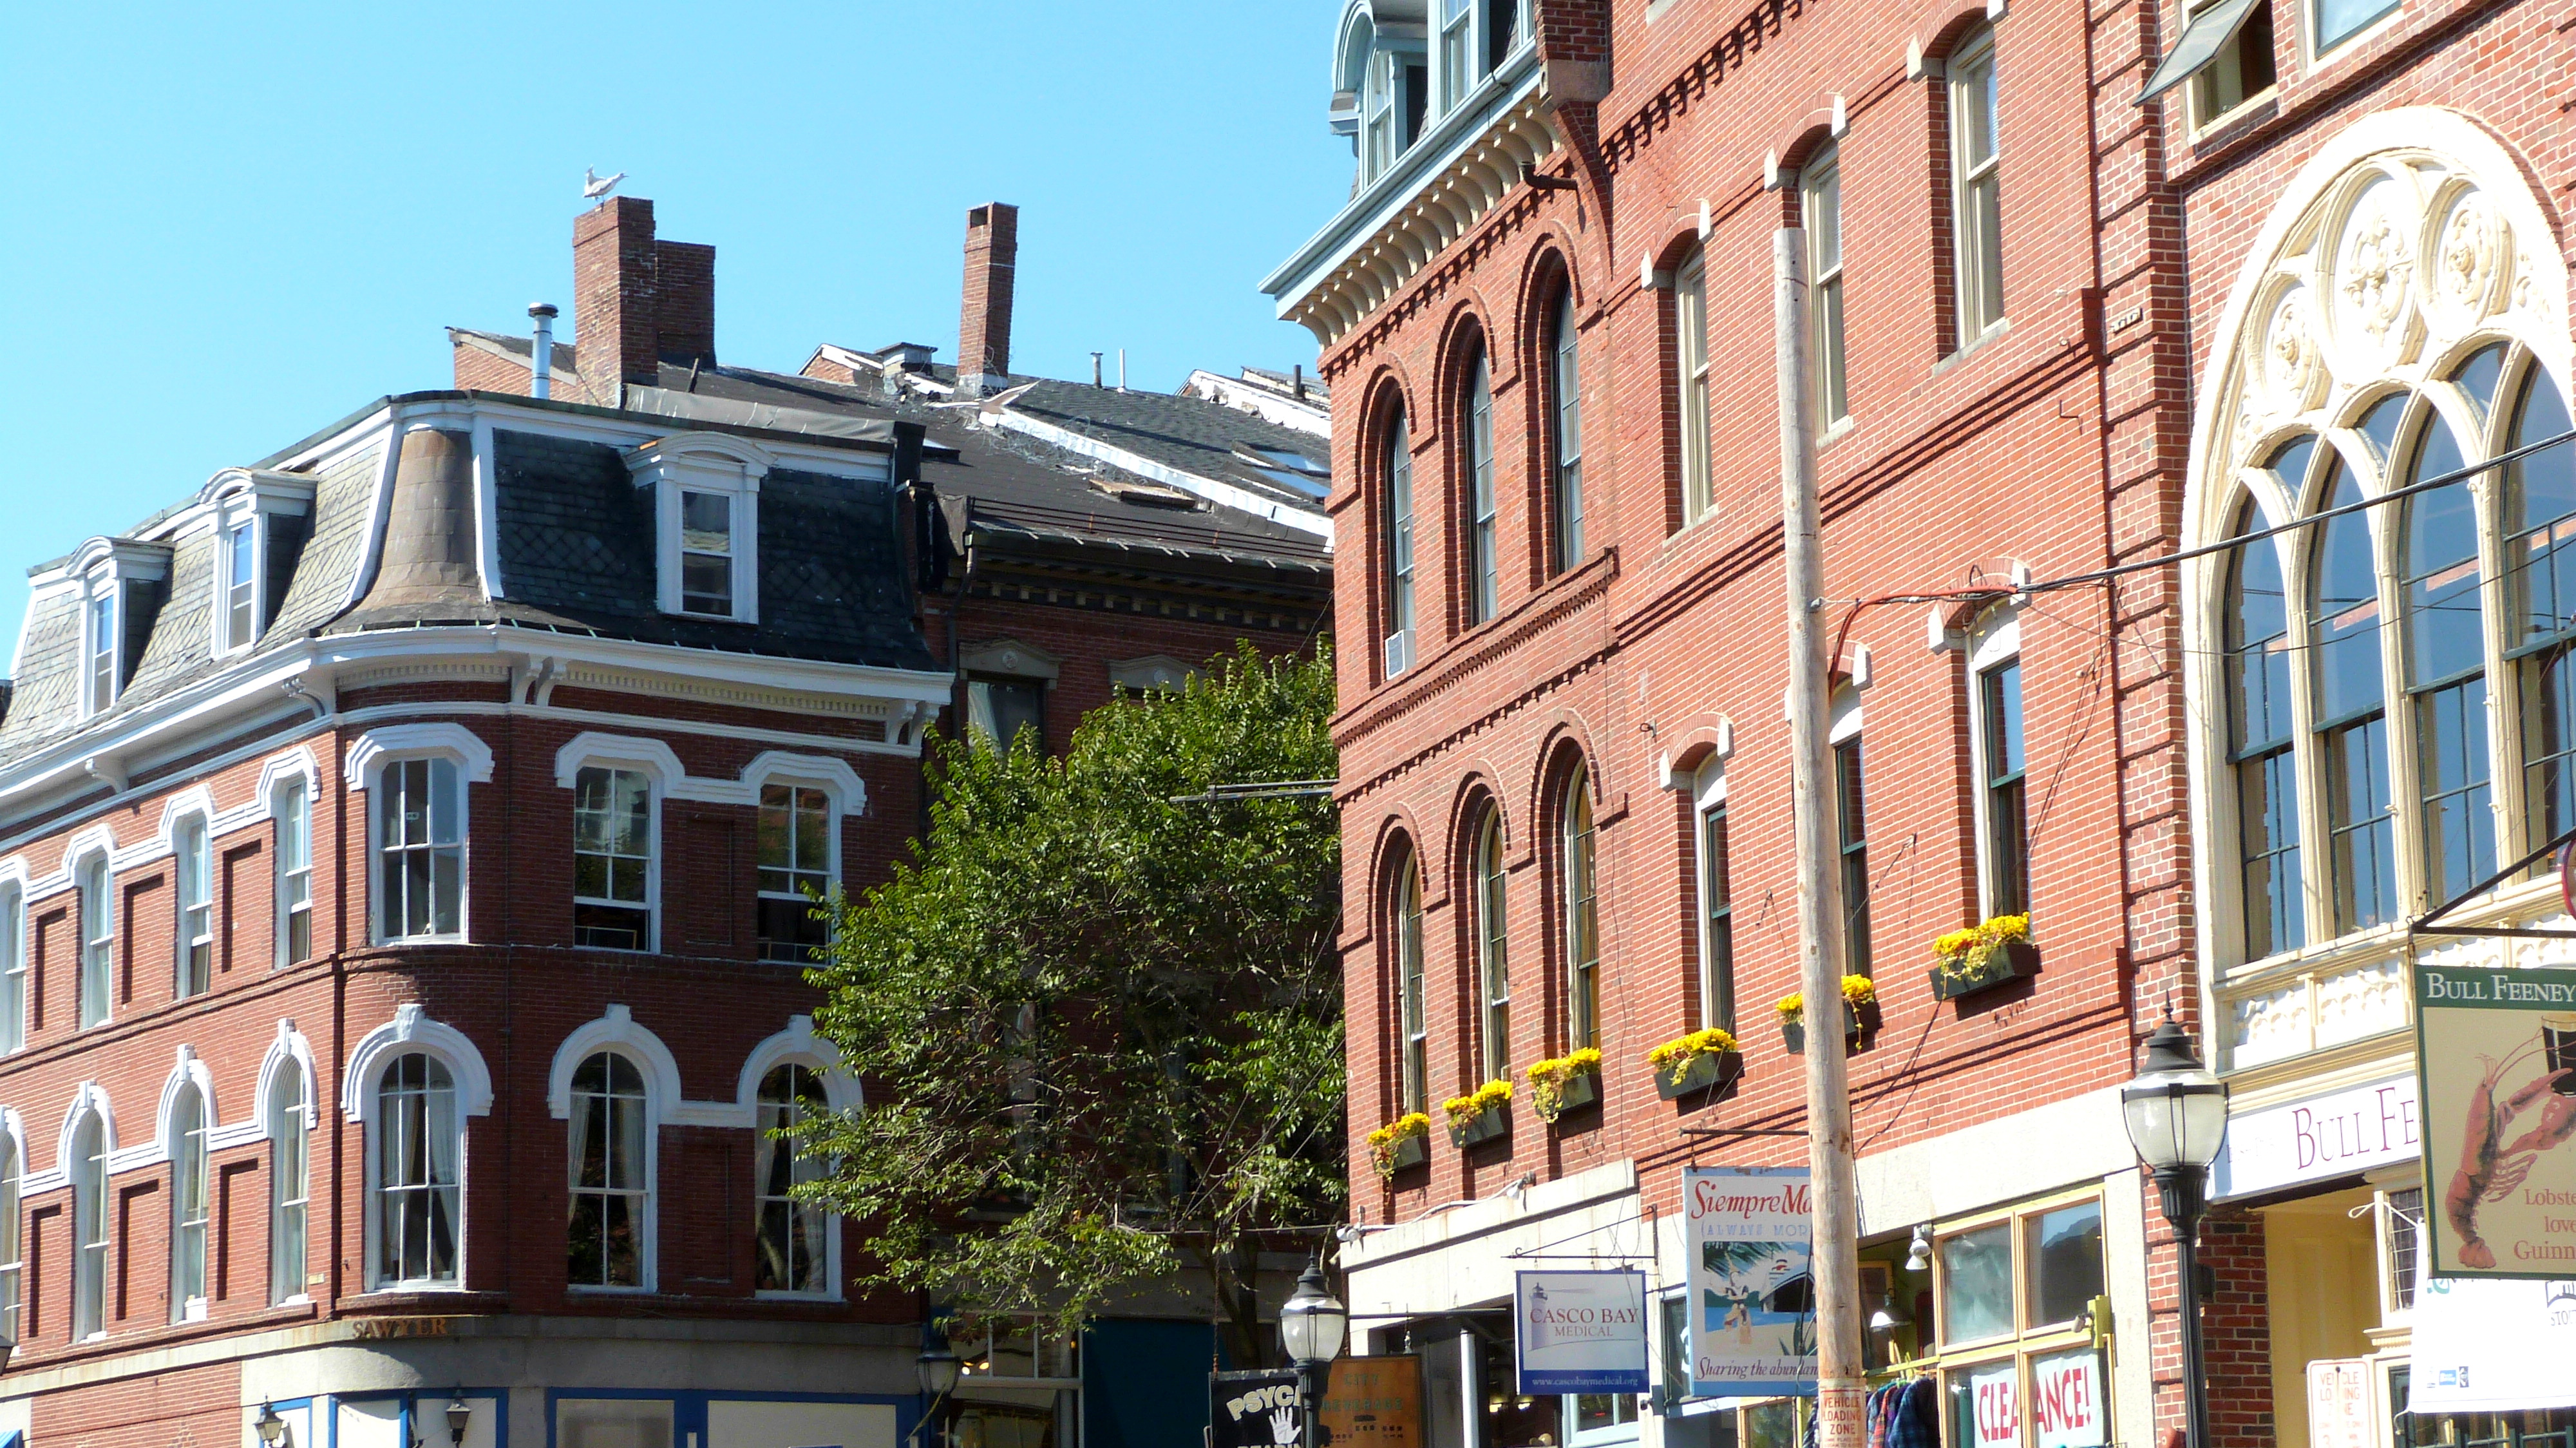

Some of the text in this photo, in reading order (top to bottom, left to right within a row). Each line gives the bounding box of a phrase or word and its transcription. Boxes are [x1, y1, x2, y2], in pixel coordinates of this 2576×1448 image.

[2426, 973, 2576, 1002] BULL FEENEY
[2292, 1107, 2370, 1170] BULL
[1690, 1180, 1781, 1219] Siempre
[1530, 1308, 1639, 1324] CASCO BAY
[353, 1317, 448, 1338] SAWYER
[1555, 1326, 1614, 1337] MEDICAL
[1696, 1357, 1749, 1380] Sharing
[1750, 1360, 1768, 1376] the
[1344, 1373, 1379, 1386] CITY
[1532, 1376, 1639, 1387] www.cascobaymedical.org
[1824, 1396, 1860, 1408] VEHICLE
[1979, 1365, 2091, 1443] CLEAANCE!
[1823, 1410, 1861, 1422] LOADING
[1830, 1424, 1855, 1435] ZONE
